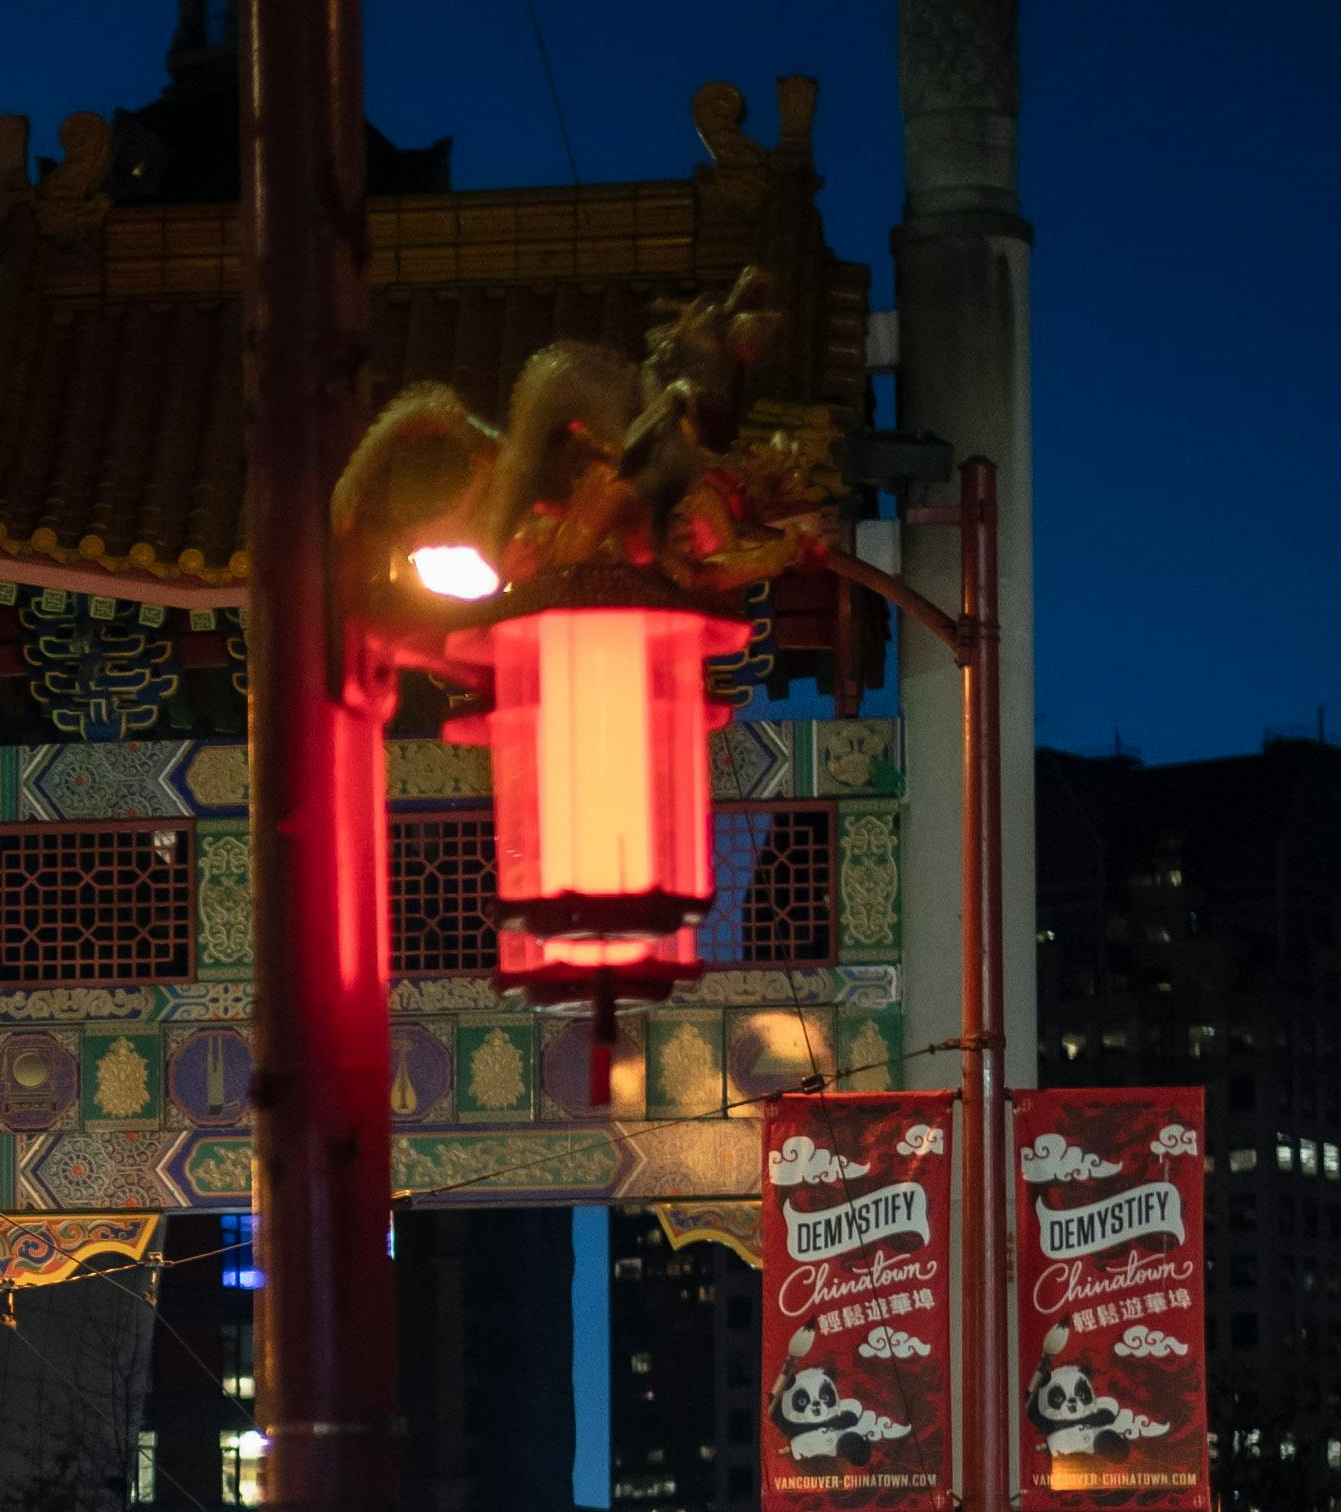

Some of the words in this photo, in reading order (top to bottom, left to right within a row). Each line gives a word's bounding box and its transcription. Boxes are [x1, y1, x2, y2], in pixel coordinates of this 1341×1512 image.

[797, 1190, 916, 1254] DEMYSTIFY
[1049, 1190, 1169, 1252] DEMYSTIFY
[778, 1250, 937, 1316] Chinatown
[1033, 1249, 1194, 1314] Chinatown
[818, 1288, 935, 1336] 輕鬆遊華埠
[1072, 1287, 1192, 1333] 輕鬆遊華埠
[774, 1474, 938, 1490] VANCOUVER-CHINATOWN.COM
[1032, 1473, 1197, 1487] VANOUVER-CHINATOWN.COM
